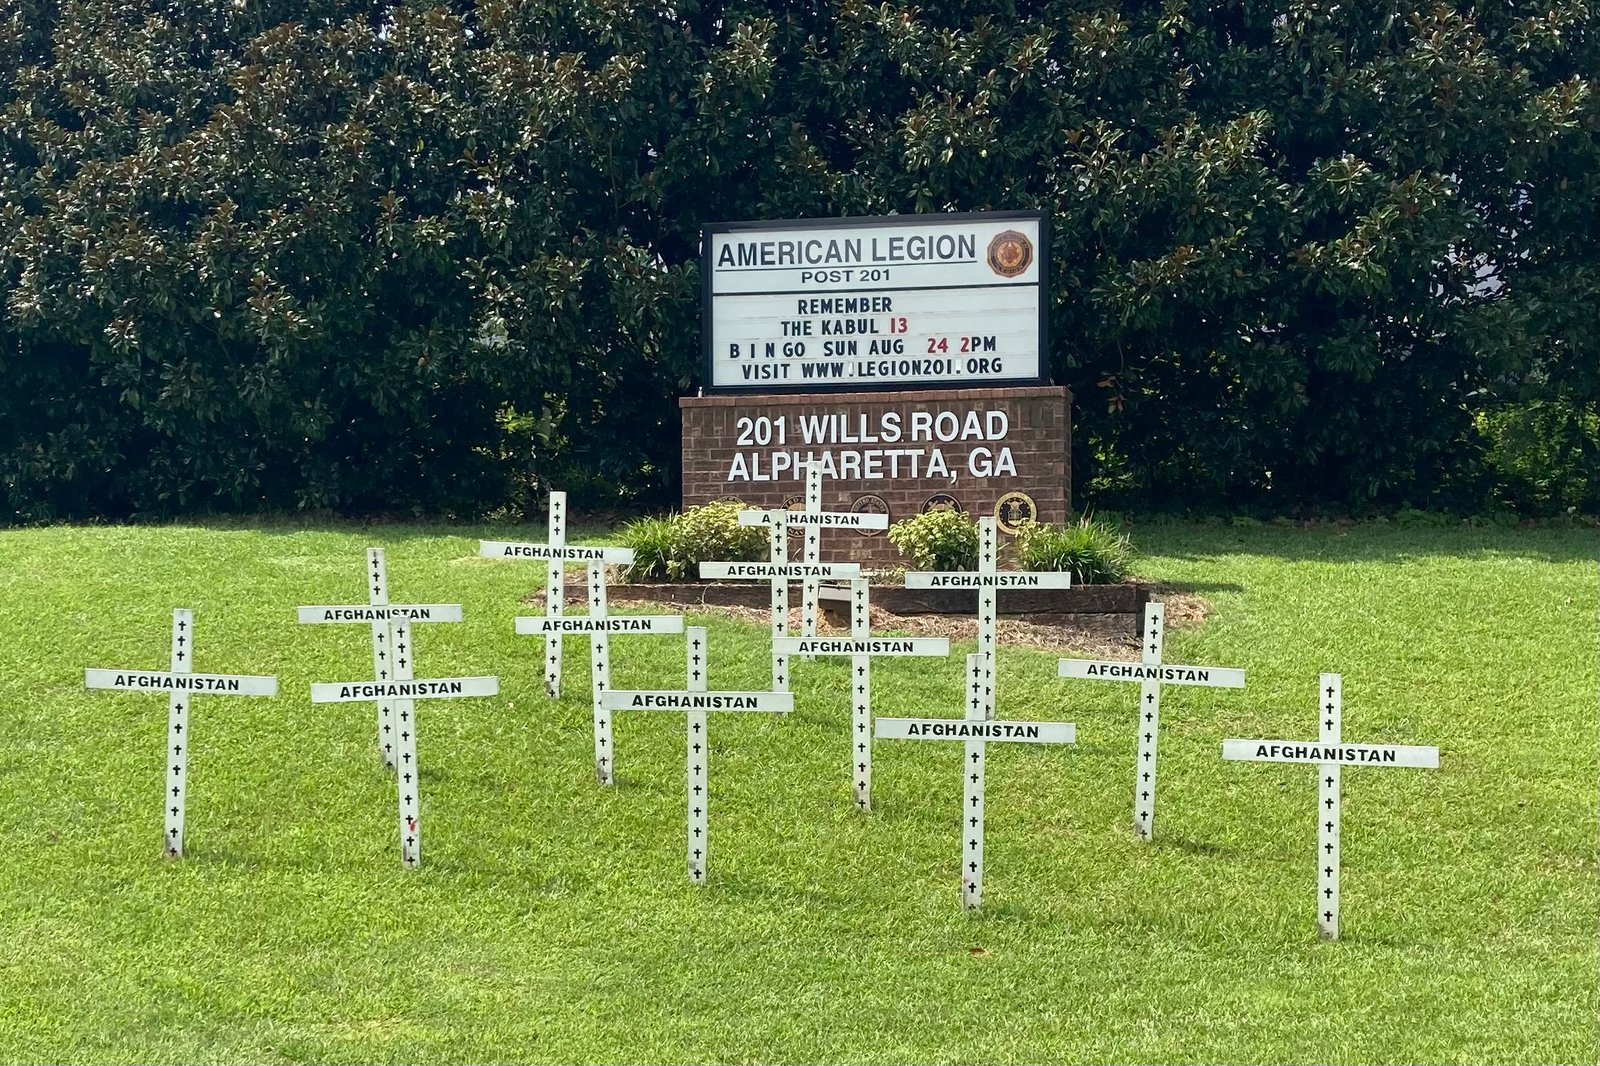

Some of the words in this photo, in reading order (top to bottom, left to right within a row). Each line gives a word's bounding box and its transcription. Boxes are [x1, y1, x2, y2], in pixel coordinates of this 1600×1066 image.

[717, 238, 863, 268] AMERICAN
[872, 234, 976, 262] LEGION
[801, 270, 852, 284] POST
[859, 268, 890, 282] 201
[797, 296, 893, 315] REMEMBER
[780, 320, 813, 337] THE
[821, 318, 880, 336] KABUL
[889, 317, 909, 334] 13
[823, 340, 858, 357] SUN
[868, 338, 905, 356] AUG
[927, 337, 949, 354] 24
[960, 335, 997, 353] 2PM
[741, 363, 791, 380] VISIT
[736, 416, 786, 446] 201
[799, 411, 902, 444] WILLS
[911, 410, 1009, 442] ROAD
[727, 448, 957, 485] ALPHARETTA,
[968, 446, 1018, 478] GA
[761, 513, 860, 525] AHANISTAN
[503, 546, 604, 559] AFGHANISTAN
[727, 565, 831, 576] AFGHANISTAN
[930, 575, 1038, 587] AFGHANISTAN
[324, 608, 430, 621] AFGHANISTAN
[542, 619, 651, 631] AFGHANISTAN
[798, 641, 914, 653] AFGHANISTAN
[1086, 664, 1209, 682] AFGHANISTAN
[114, 674, 239, 691] AFGHANISTAN
[339, 681, 462, 698] AFGHANISTAN
[631, 694, 758, 709] AFGHANISTAN
[907, 723, 1039, 739] AFGHANISTAN
[1255, 745, 1396, 762] AFGHANISTAN
